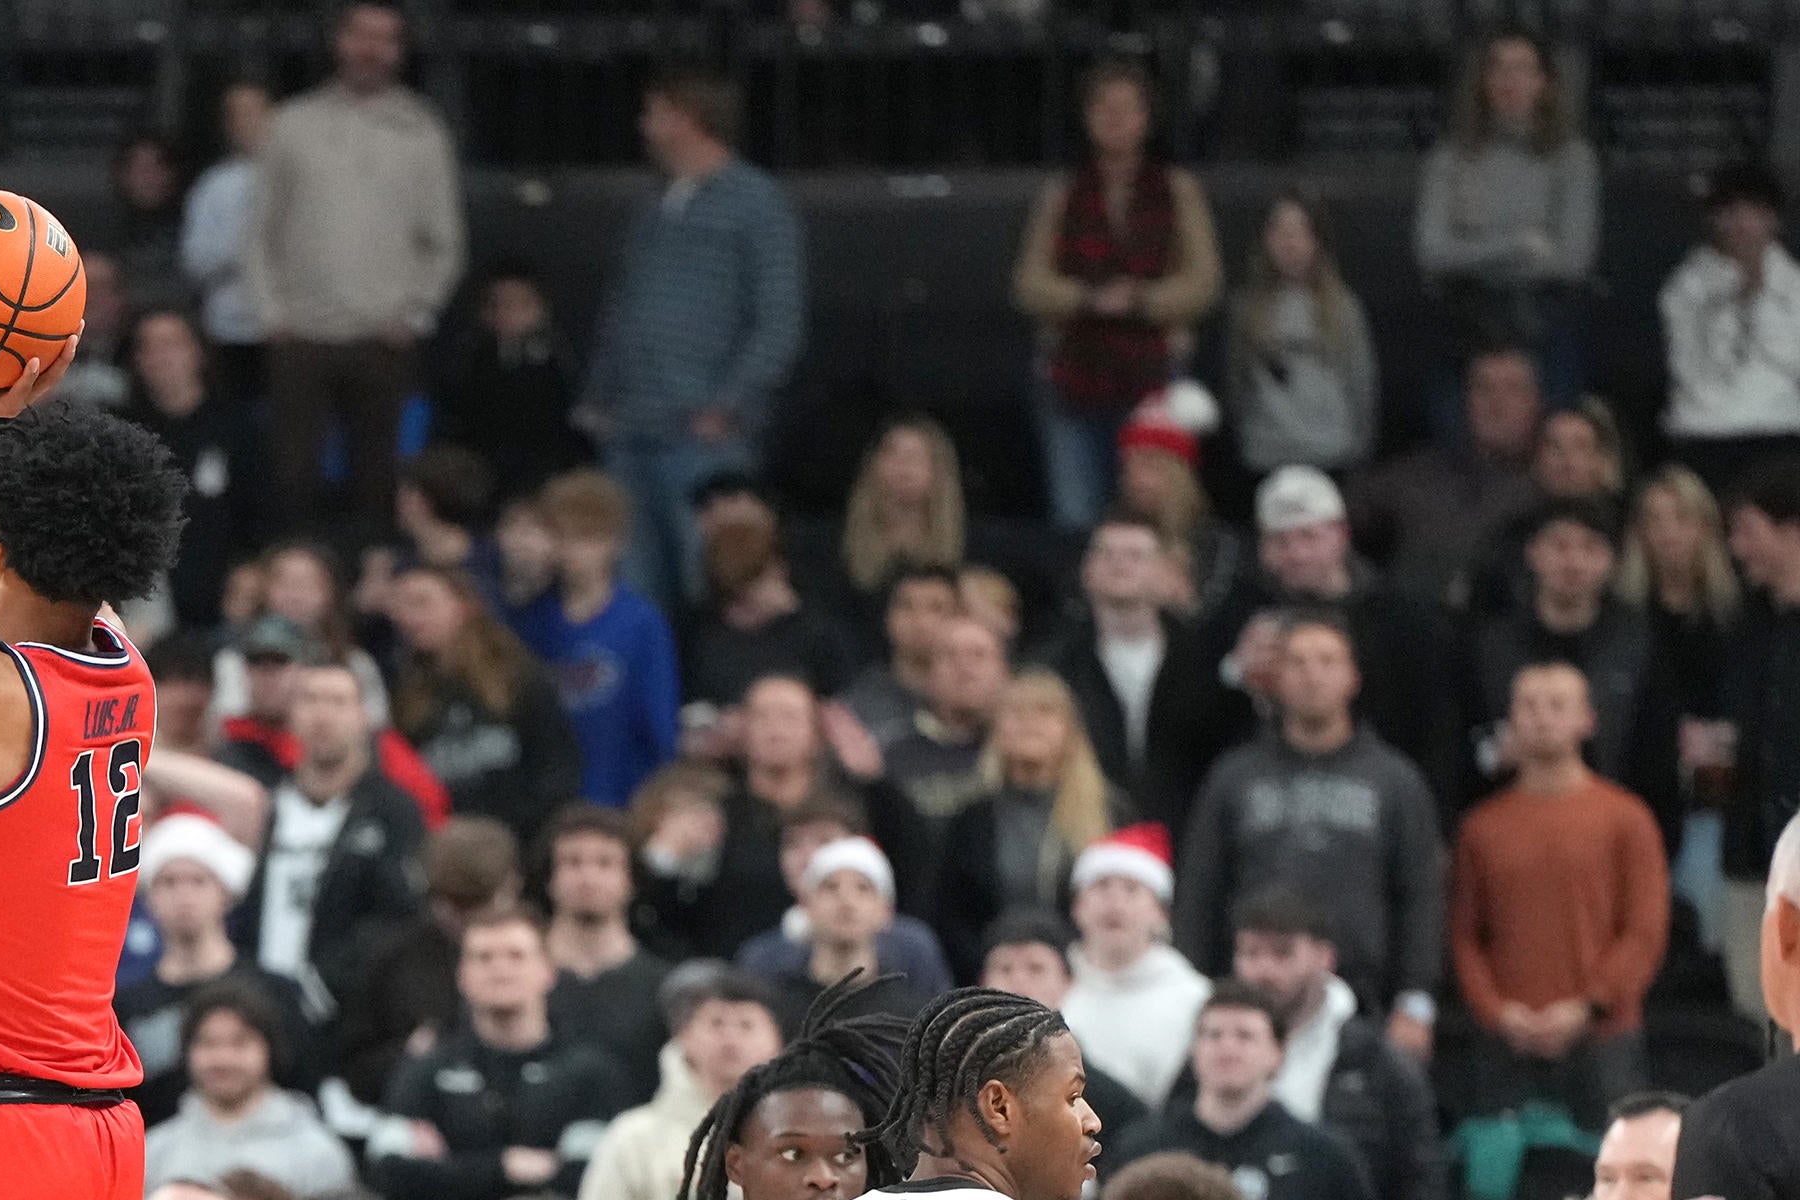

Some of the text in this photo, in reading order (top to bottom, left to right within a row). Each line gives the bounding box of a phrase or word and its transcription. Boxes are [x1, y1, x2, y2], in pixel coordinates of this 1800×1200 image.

[83, 693, 140, 740] LUIS JR.
[67, 738, 142, 887] 12
